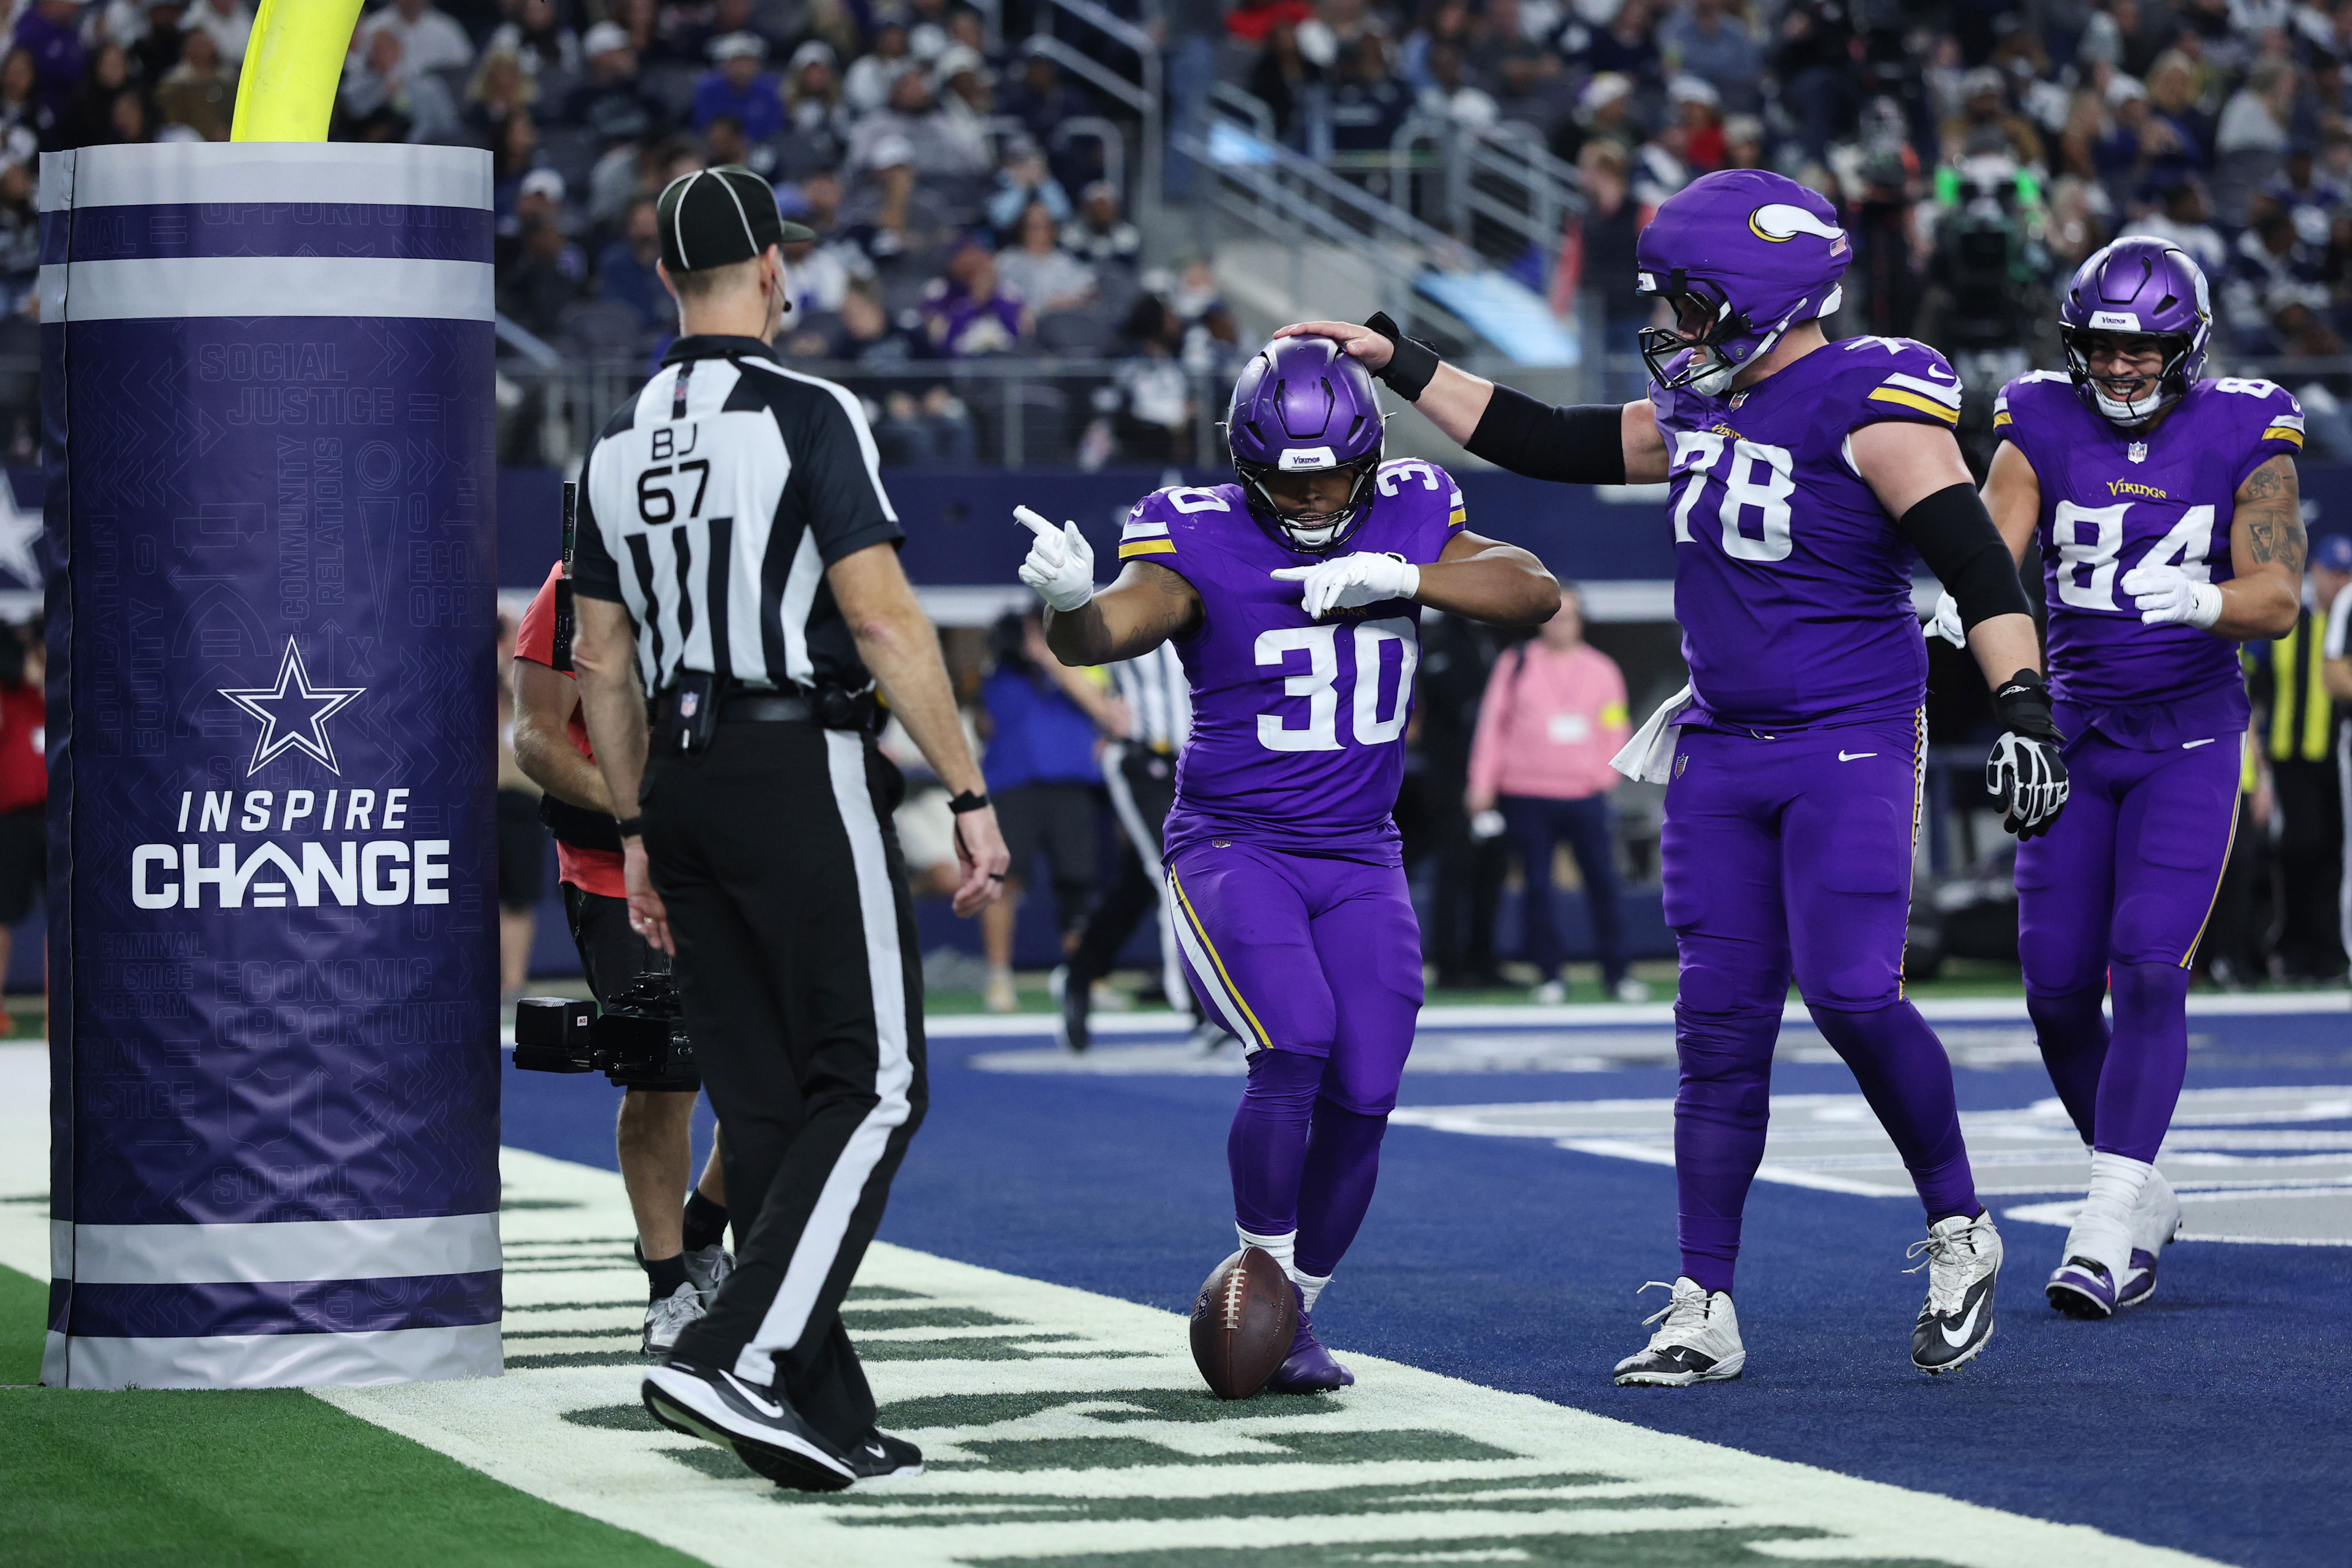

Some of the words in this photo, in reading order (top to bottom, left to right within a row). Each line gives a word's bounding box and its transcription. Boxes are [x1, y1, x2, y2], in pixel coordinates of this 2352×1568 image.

[199, 343, 348, 381] SOCIAL
[226, 387, 395, 426] JUSTICE
[652, 423, 697, 461] BJ
[637, 459, 710, 526] 67
[1673, 430, 1796, 562] 78
[313, 436, 345, 606] RELATIONS
[2053, 499, 2216, 612] 84
[91, 514, 122, 758] EDUCATION
[129, 598, 168, 757] EQUITY
[1254, 616, 1419, 752] 30
[177, 788, 410, 833] INSPIRE
[131, 839, 450, 910] CHANGE
[98, 932, 207, 960] CRIMINAL
[98, 962, 194, 990] JUSTICE
[215, 957, 433, 1003] ECONOMIC
[98, 991, 190, 1019] REFORM
[215, 1000, 483, 1049] OPPORTUNITY
[212, 1163, 360, 1205] SOCIAL
